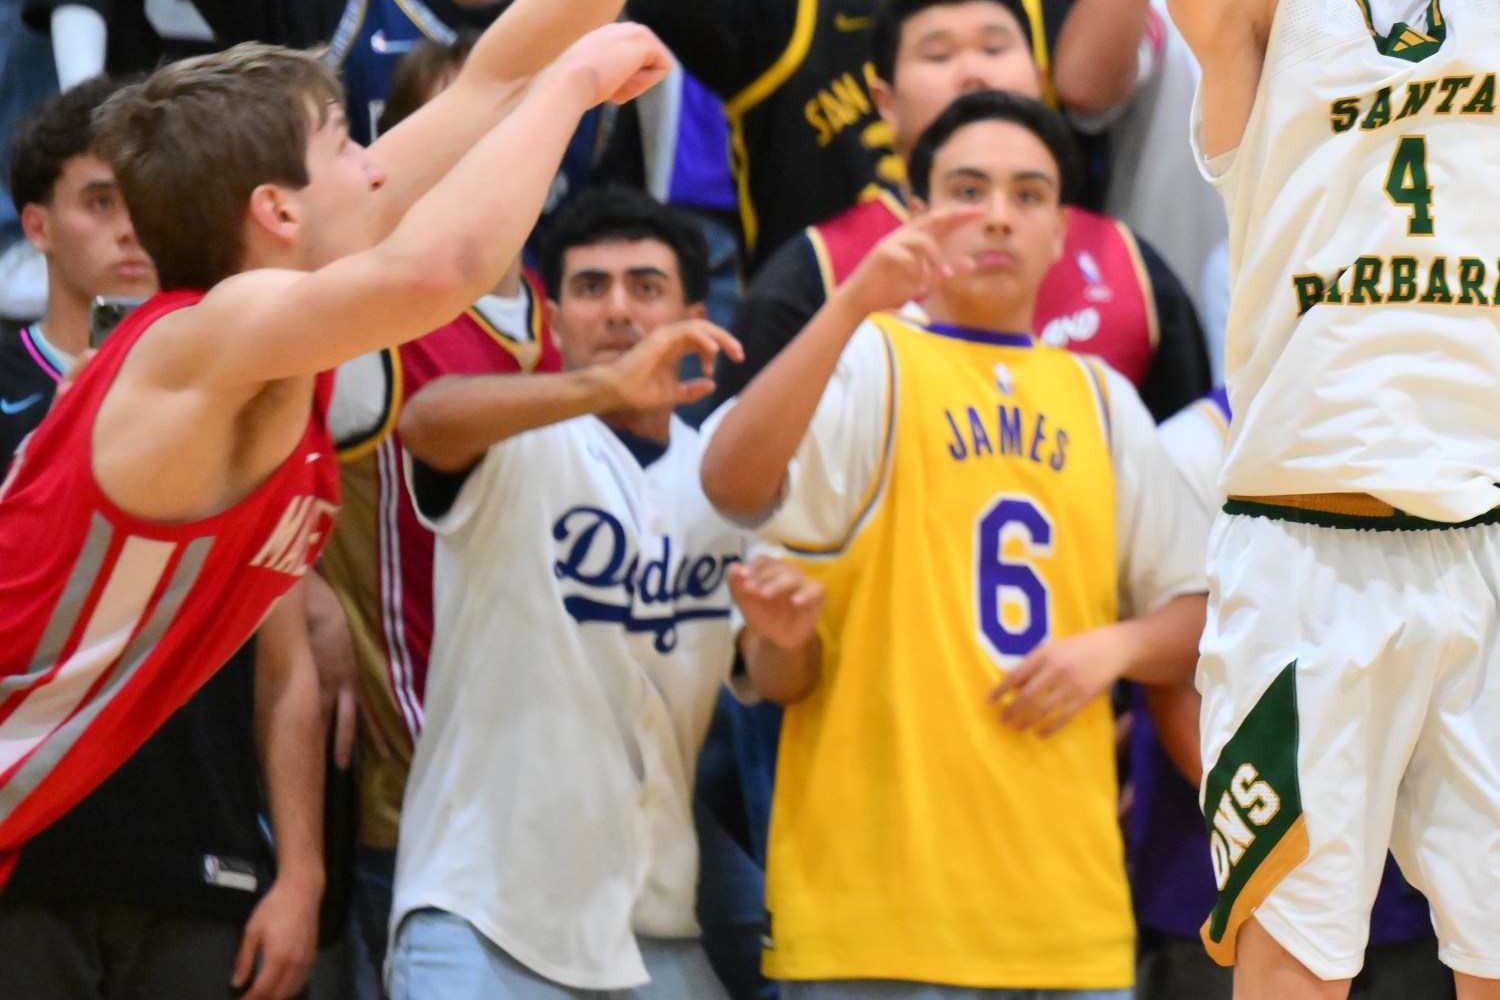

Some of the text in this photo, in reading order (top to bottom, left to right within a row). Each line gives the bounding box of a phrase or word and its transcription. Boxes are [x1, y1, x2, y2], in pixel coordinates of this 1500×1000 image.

[1330, 72, 1496, 134] SANTA
[1383, 134, 1435, 237] 4
[945, 404, 1068, 472] JAMES
[974, 492, 1054, 672] 6
[1210, 762, 1281, 892] ONS
